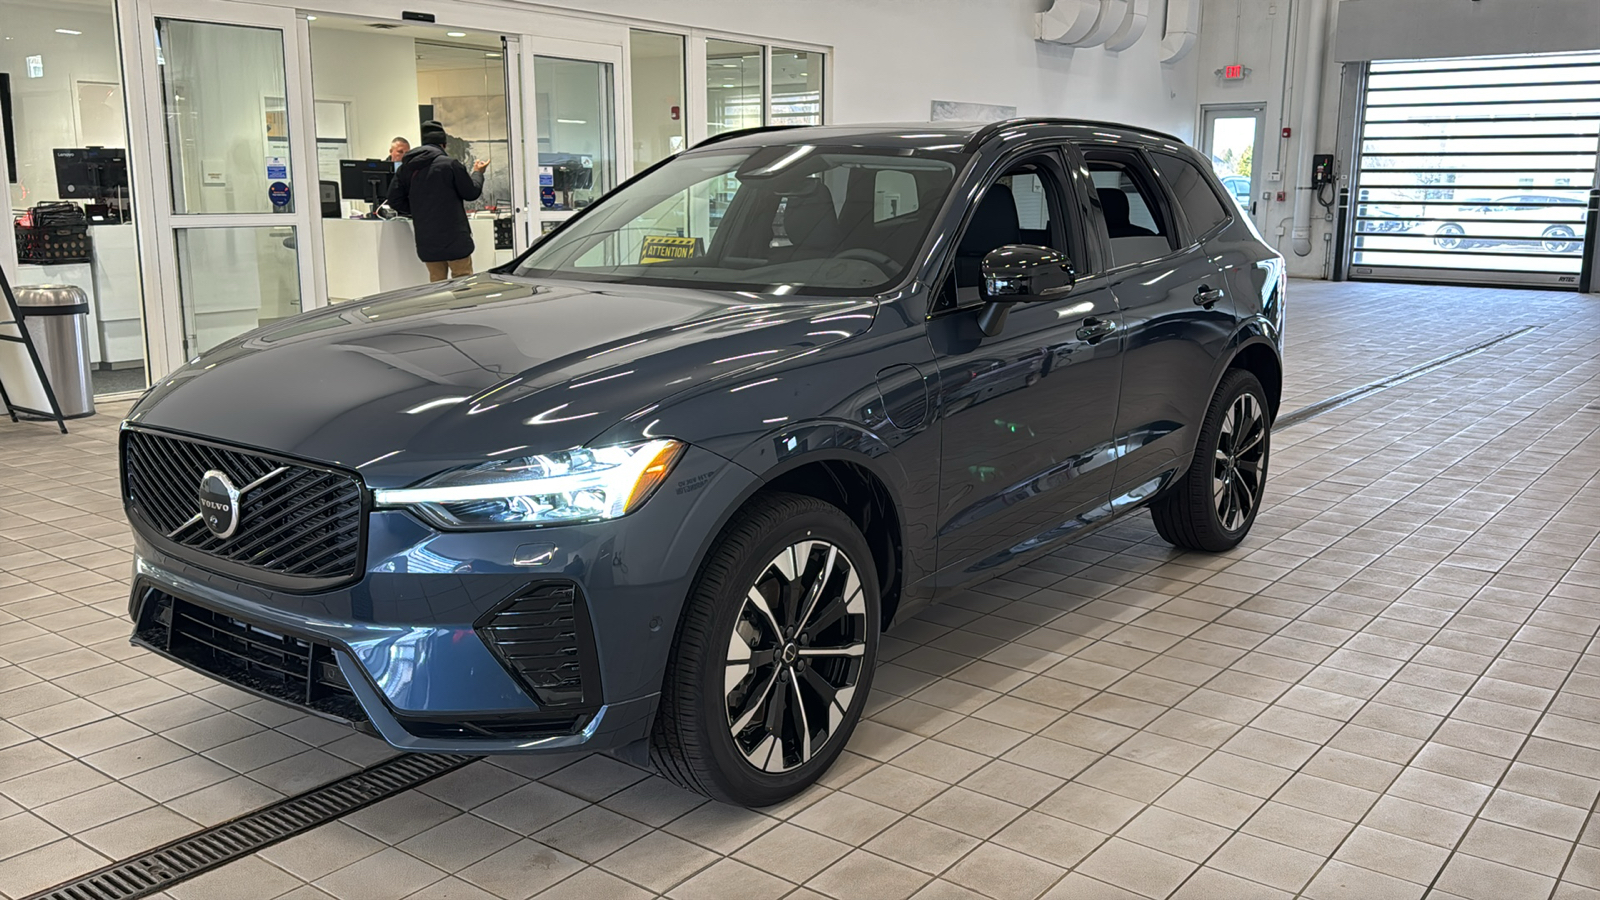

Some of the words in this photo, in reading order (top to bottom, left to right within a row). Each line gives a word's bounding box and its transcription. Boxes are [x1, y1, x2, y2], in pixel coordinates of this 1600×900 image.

[1225, 65, 1241, 78] EXIT
[647, 245, 688, 258] ATTENTION
[200, 498, 229, 512] VOLVO
